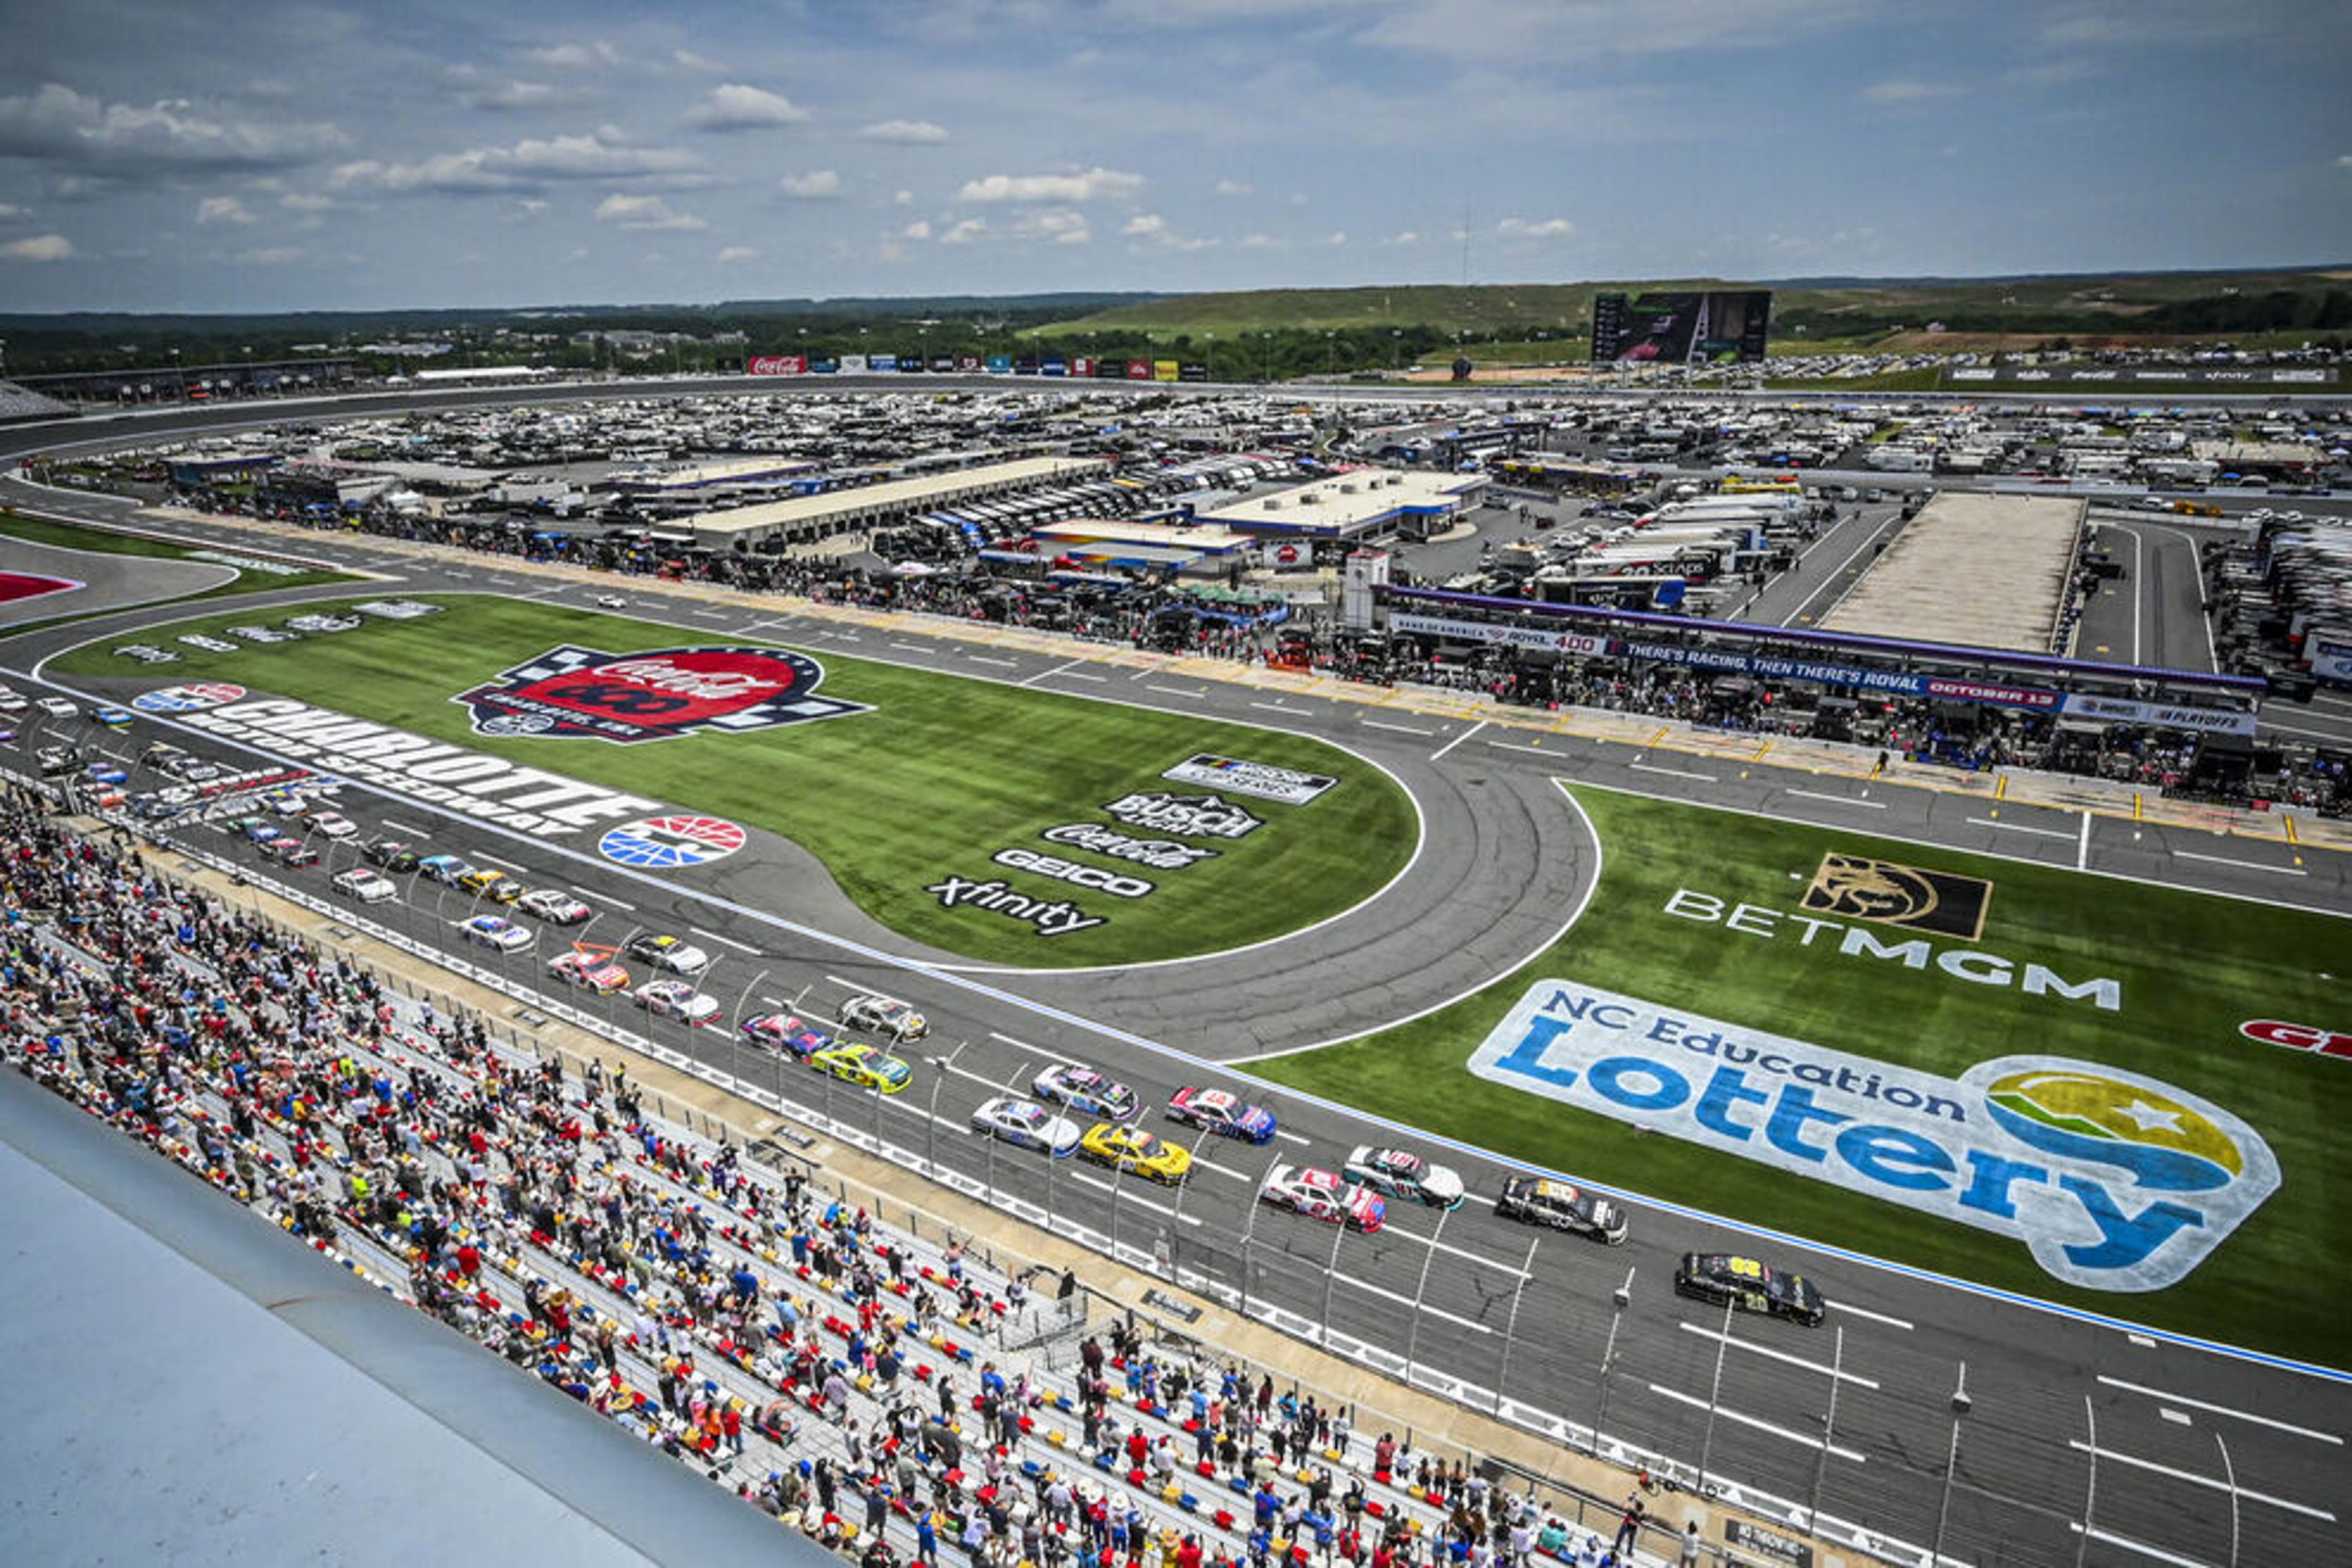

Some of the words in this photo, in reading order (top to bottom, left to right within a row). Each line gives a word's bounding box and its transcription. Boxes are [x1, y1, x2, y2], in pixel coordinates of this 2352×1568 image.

[1439, 624, 1484, 638] AMERICA
[1555, 635, 1596, 652] 400
[1627, 643, 1684, 662] THERE'S
[1687, 650, 1749, 671] RACING,
[1753, 658, 1792, 674] THEN
[1796, 663, 1860, 684] THERE'S
[1930, 681, 2023, 701] OCTOBER
[2029, 691, 2054, 704] 13
[2173, 710, 2240, 728] PLAYOFFS
[211, 699, 665, 827] CHARLOTTE
[312, 755, 583, 837] SPEEDWAY
[1106, 795, 1259, 838] BUSCH
[993, 848, 1153, 897] GEICO
[927, 877, 1105, 935] xfinity
[1662, 888, 2122, 1012] BETMGM
[1542, 989, 1639, 1030] NC
[1644, 1017, 1967, 1123] Education
[1493, 1014, 2205, 1270] Lottery
